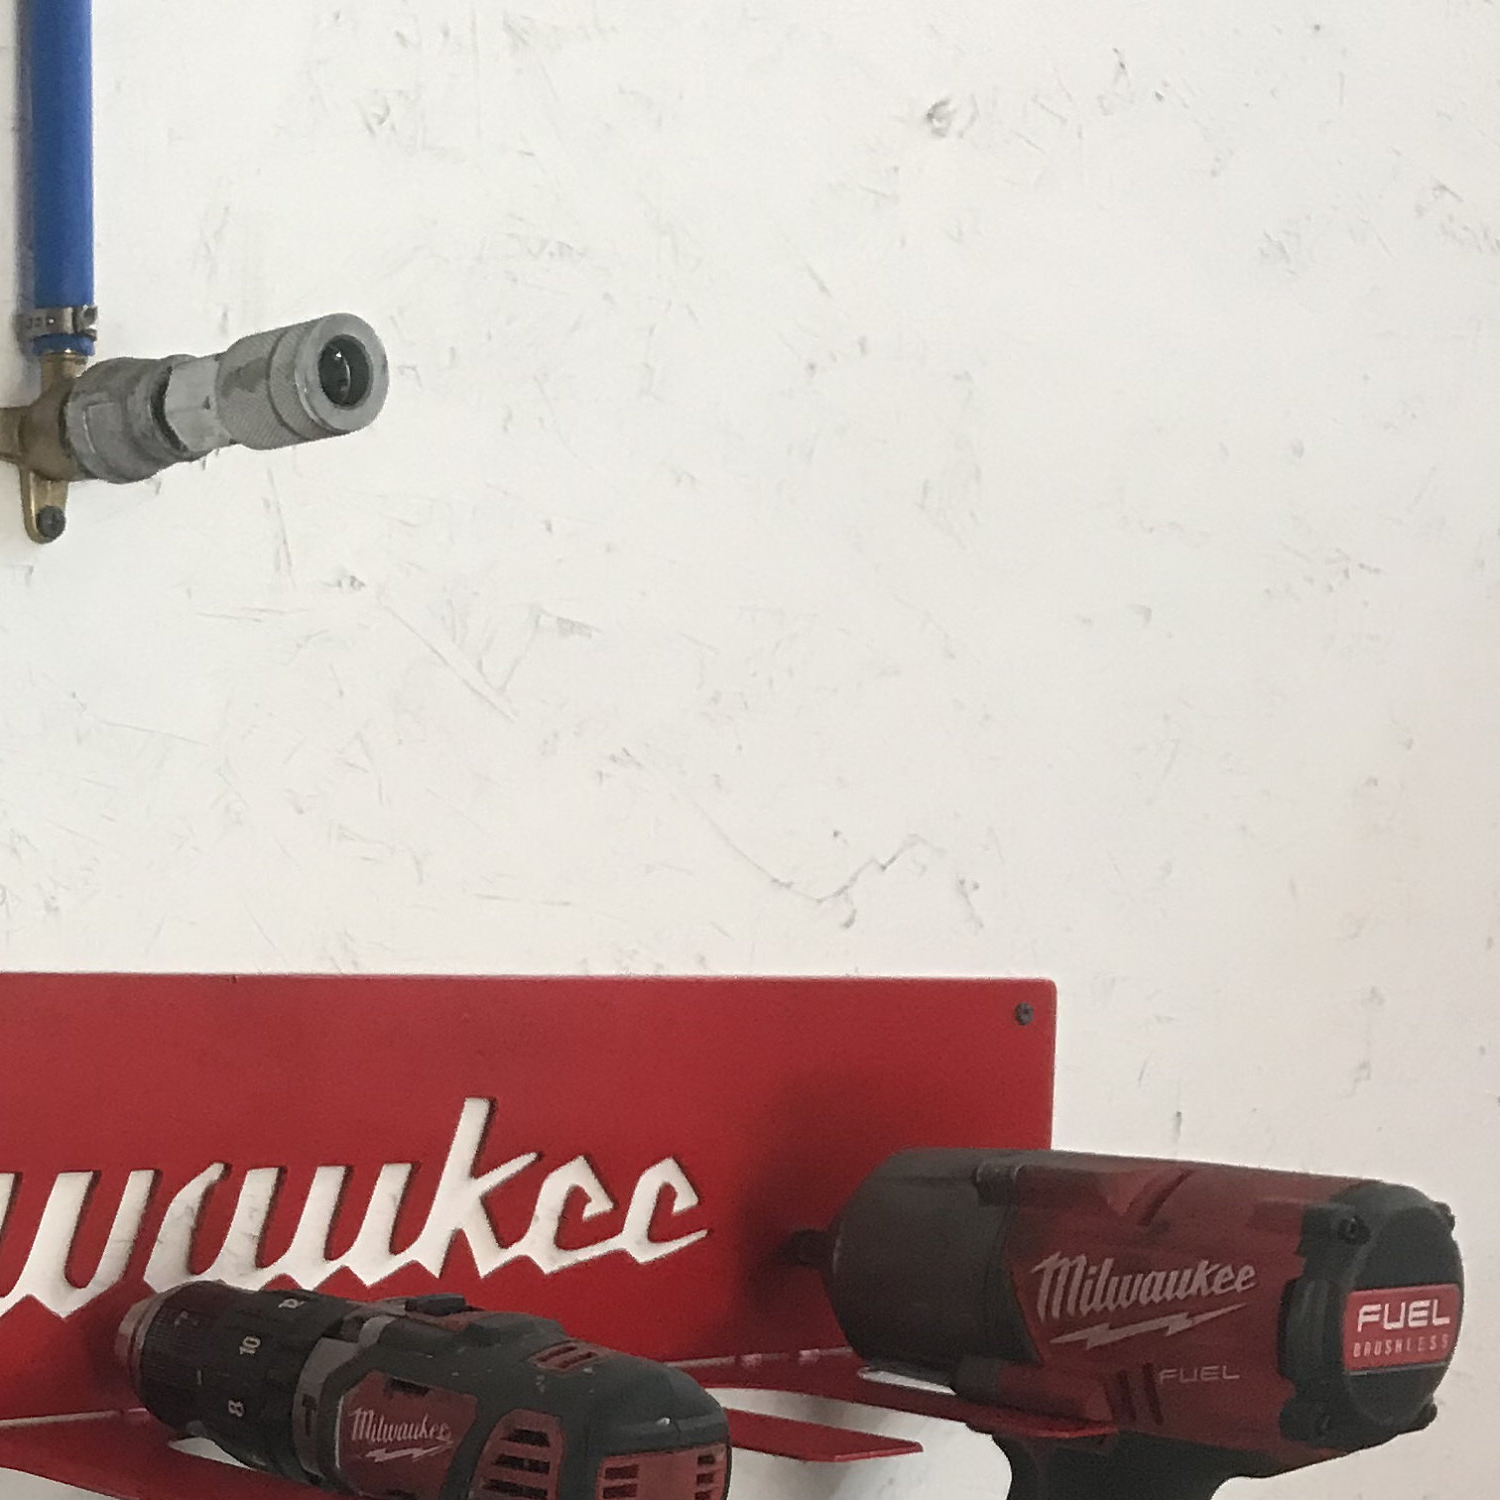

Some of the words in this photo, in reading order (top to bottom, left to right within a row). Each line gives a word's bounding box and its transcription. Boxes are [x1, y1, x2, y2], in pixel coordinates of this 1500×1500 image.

[1030, 1250, 1258, 1323] Milwaukee
[1357, 1298, 1451, 1333] FUEL
[239, 1336, 262, 1356] 10
[1353, 1334, 1450, 1359] BRUSHLESS
[1158, 1364, 1241, 1385] FUEL
